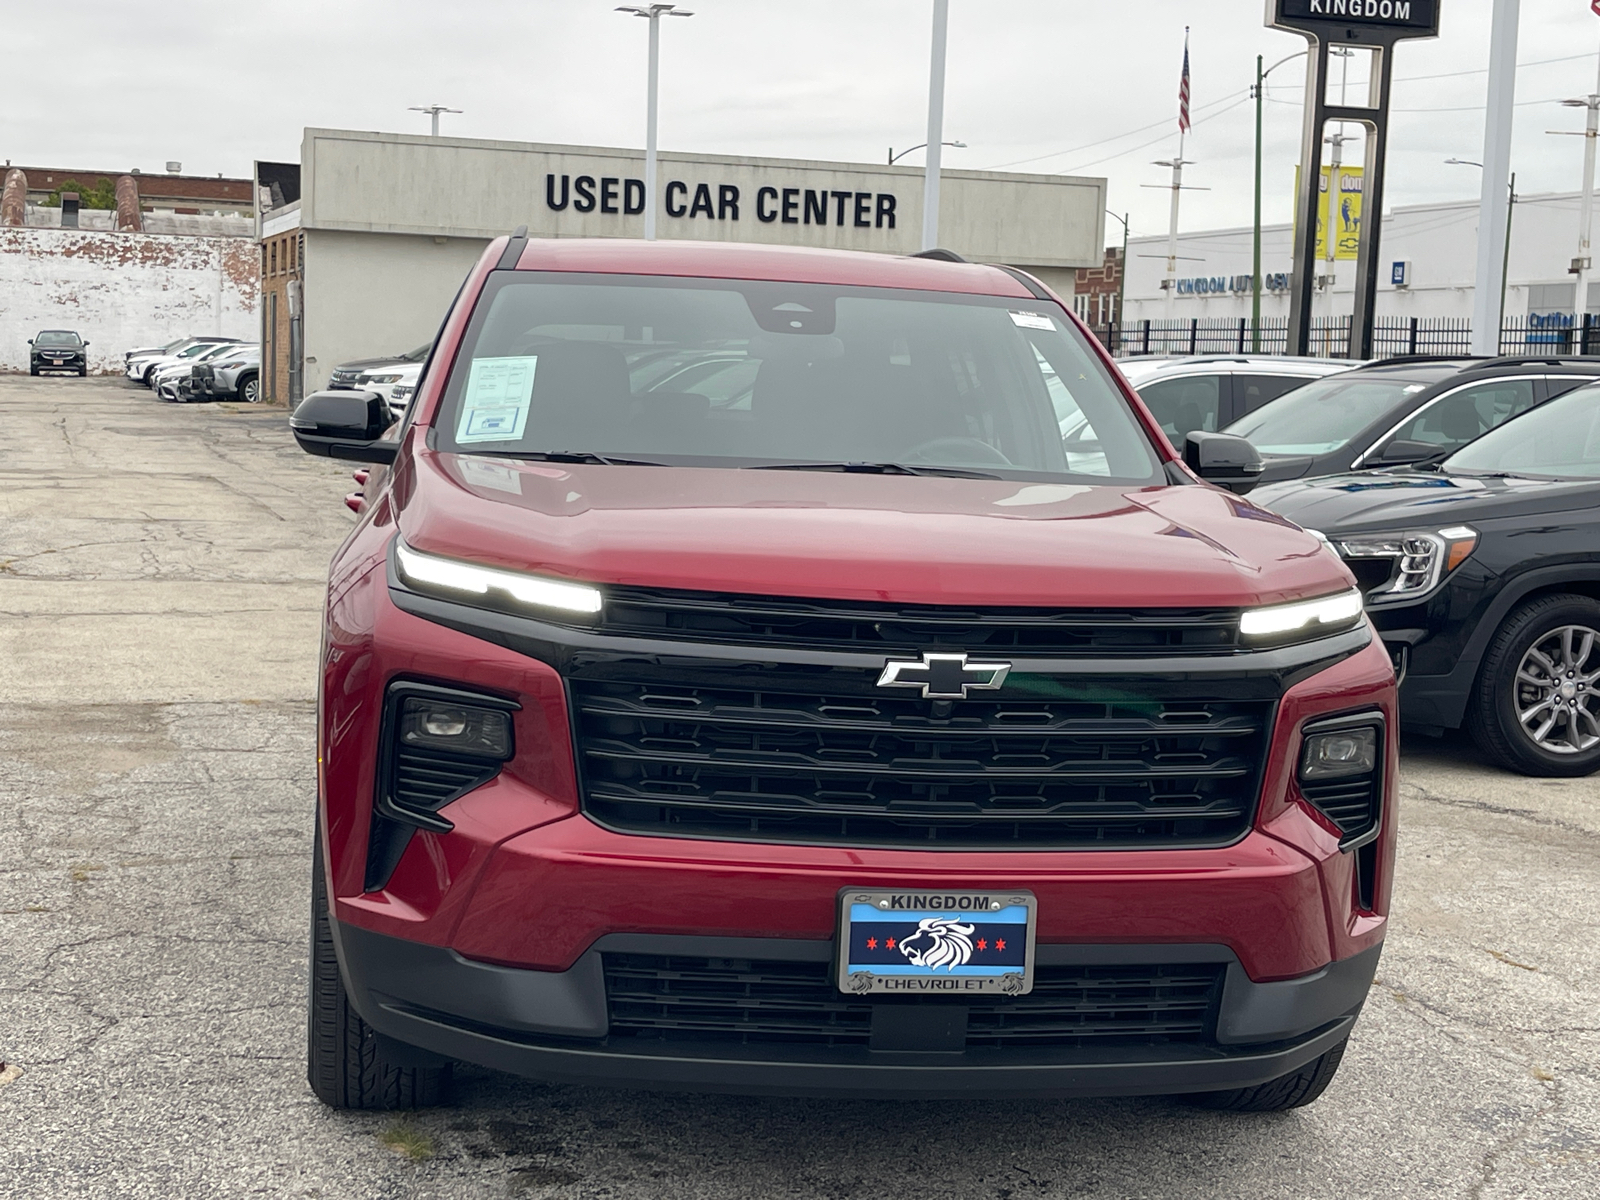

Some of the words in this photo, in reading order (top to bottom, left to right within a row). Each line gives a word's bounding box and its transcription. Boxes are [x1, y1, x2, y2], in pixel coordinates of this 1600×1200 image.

[1309, 0, 1411, 20] KINGDOM
[546, 173, 646, 215] USED
[665, 180, 740, 221] CAR
[756, 186, 897, 229] CENTER
[1176, 276, 1227, 294] KINGDOM
[1228, 274, 1263, 293] AUT
[891, 895, 989, 910] KINGDOM
[885, 979, 987, 990] CHEVROLET
